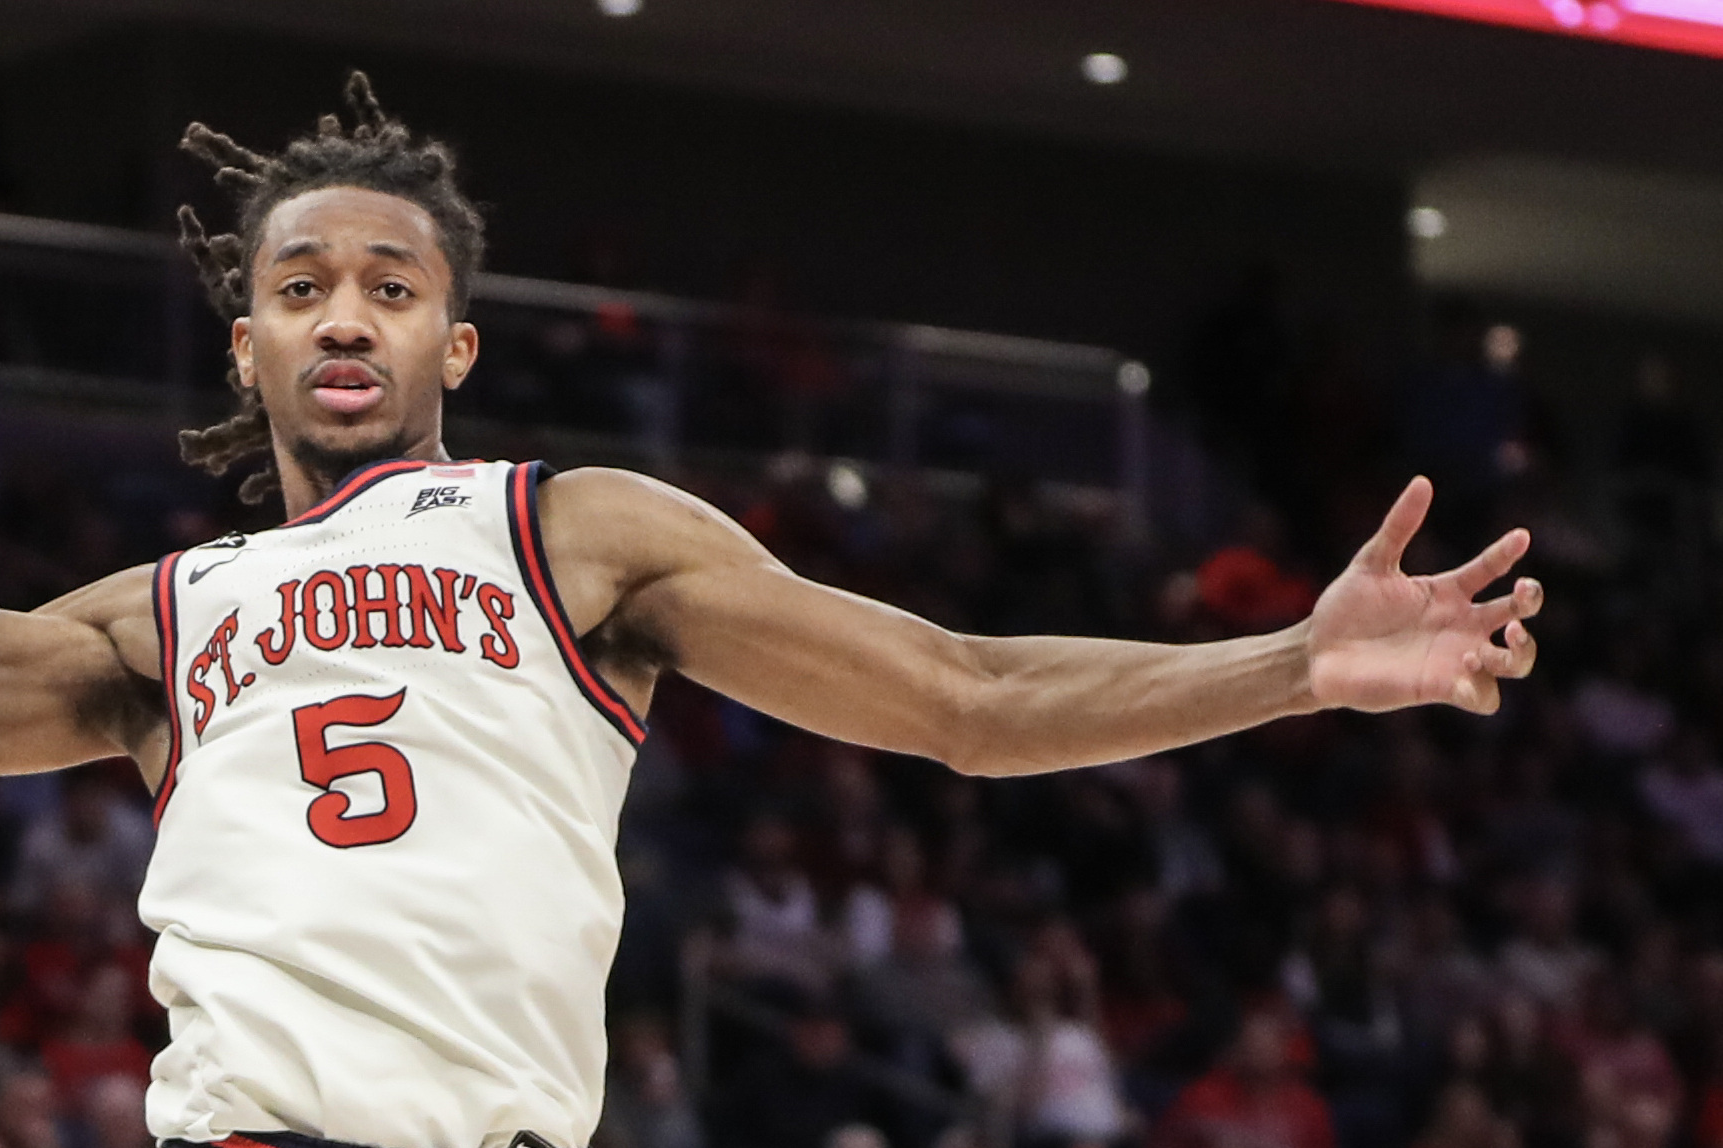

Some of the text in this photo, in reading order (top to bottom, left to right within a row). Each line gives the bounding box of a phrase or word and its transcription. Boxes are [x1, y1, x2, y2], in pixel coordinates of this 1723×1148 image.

[410, 496, 473, 512] EAST
[417, 486, 460, 500] BIG
[186, 563, 520, 742] ST. JOHN'S
[291, 686, 417, 849] 5
